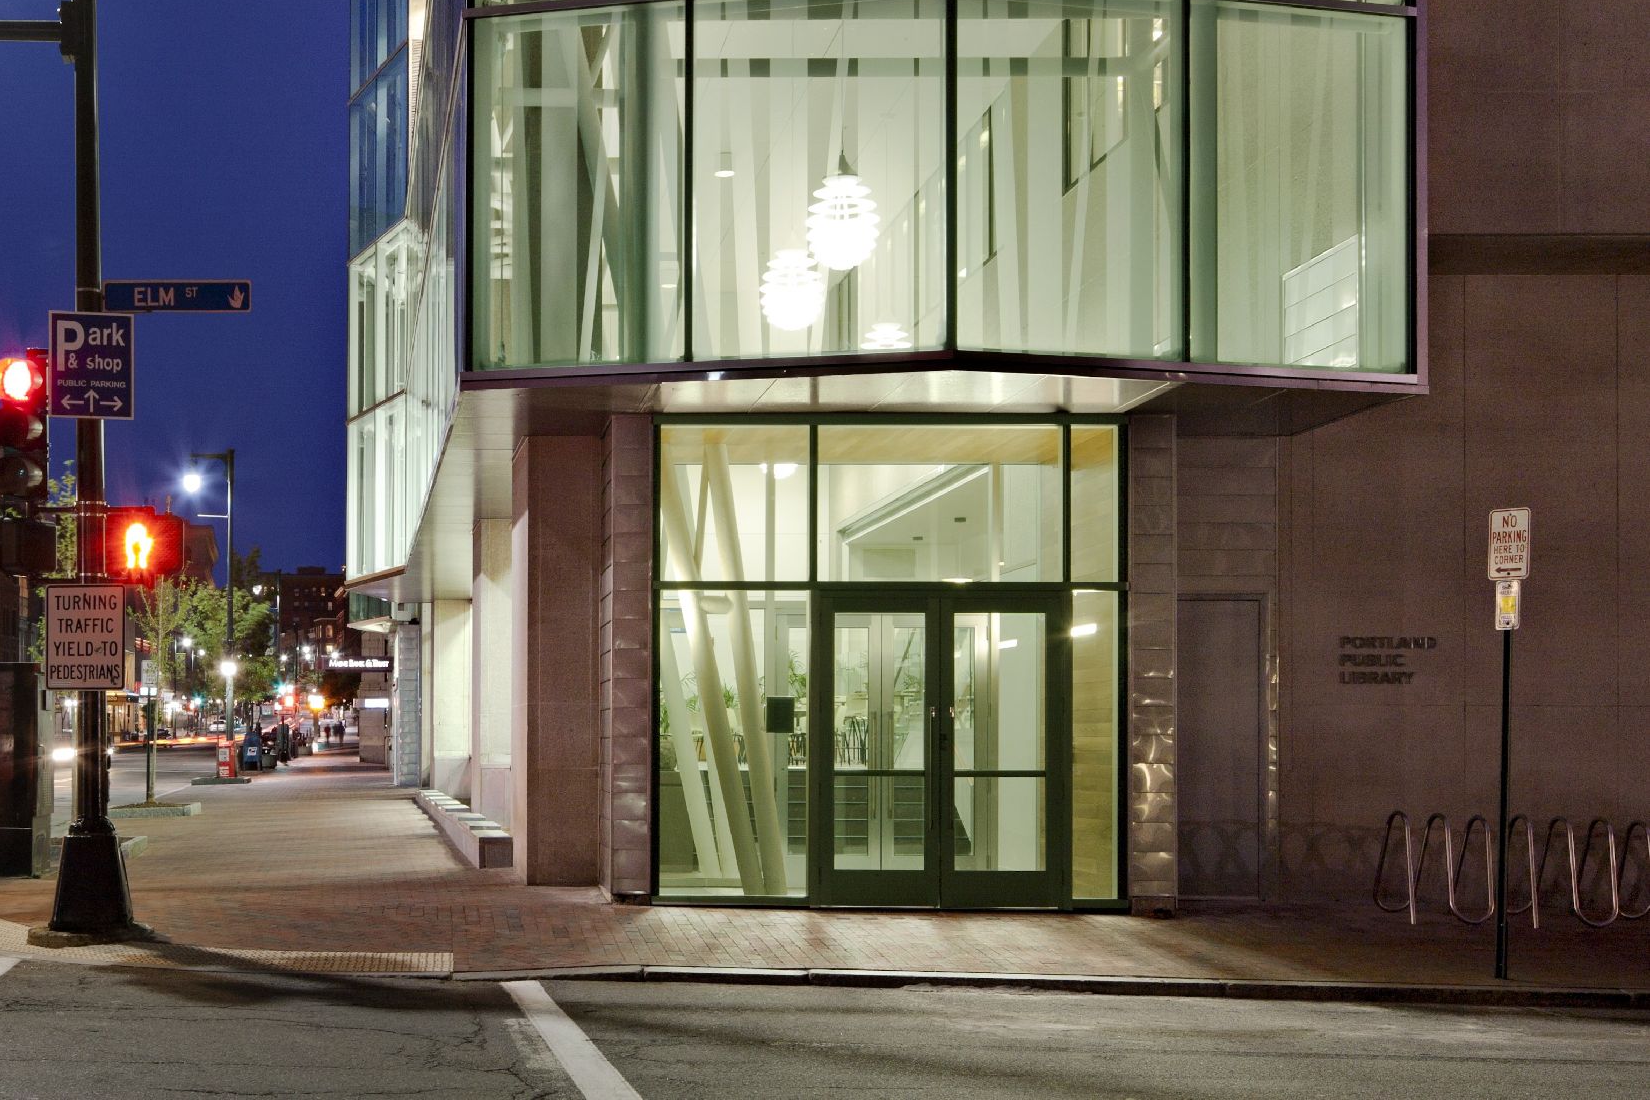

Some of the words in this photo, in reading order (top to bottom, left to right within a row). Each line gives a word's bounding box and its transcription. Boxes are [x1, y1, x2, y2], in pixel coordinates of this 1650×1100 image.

[133, 287, 175, 307] ELM
[185, 286, 198, 298] ST
[56, 320, 126, 372] Park
[67, 352, 78, 369] &
[86, 354, 122, 373] shop
[57, 379, 87, 387] PUBLIC
[90, 380, 126, 388] PARKING
[1502, 515, 1518, 528] NO
[1492, 530, 1527, 544] PARKING
[1493, 545, 1512, 554] HERE
[1515, 544, 1525, 553] TO
[1494, 555, 1524, 565] CORNER
[54, 595, 117, 611] TURNING
[57, 618, 114, 633] TRAFFIC
[53, 641, 94, 657] YIELD
[102, 641, 118, 657] TO
[1339, 636, 1437, 649] PORTLAND
[1339, 653, 1406, 667] PUBLIC
[49, 664, 121, 680] PEDESTRIANS
[1339, 671, 1415, 685] LIBRARY
